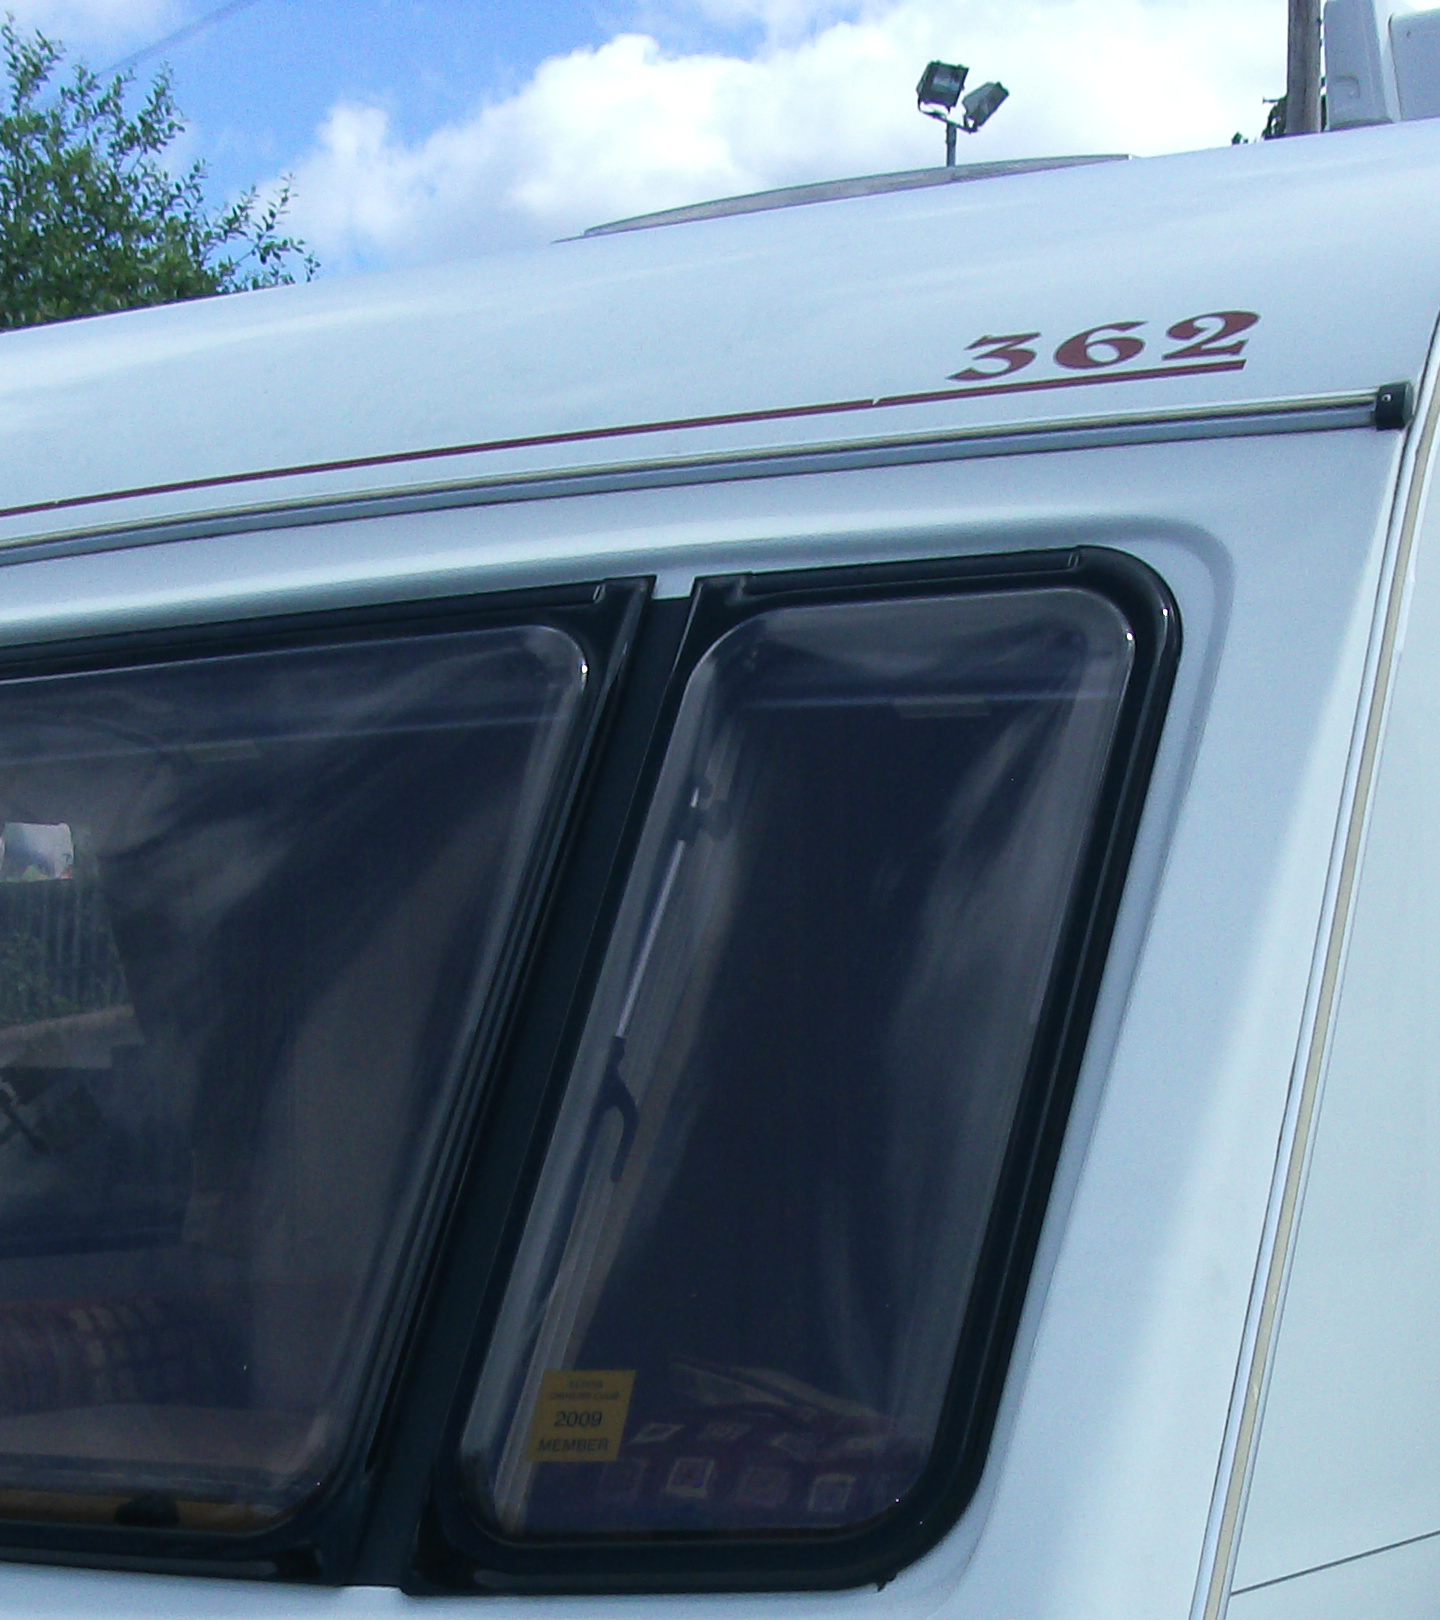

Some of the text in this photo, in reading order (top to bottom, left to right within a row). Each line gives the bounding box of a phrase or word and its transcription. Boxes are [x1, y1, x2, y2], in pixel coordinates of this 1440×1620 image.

[945, 310, 1260, 382] 362
[554, 1410, 603, 1428] 2009
[538, 1438, 610, 1452] MEMBER
